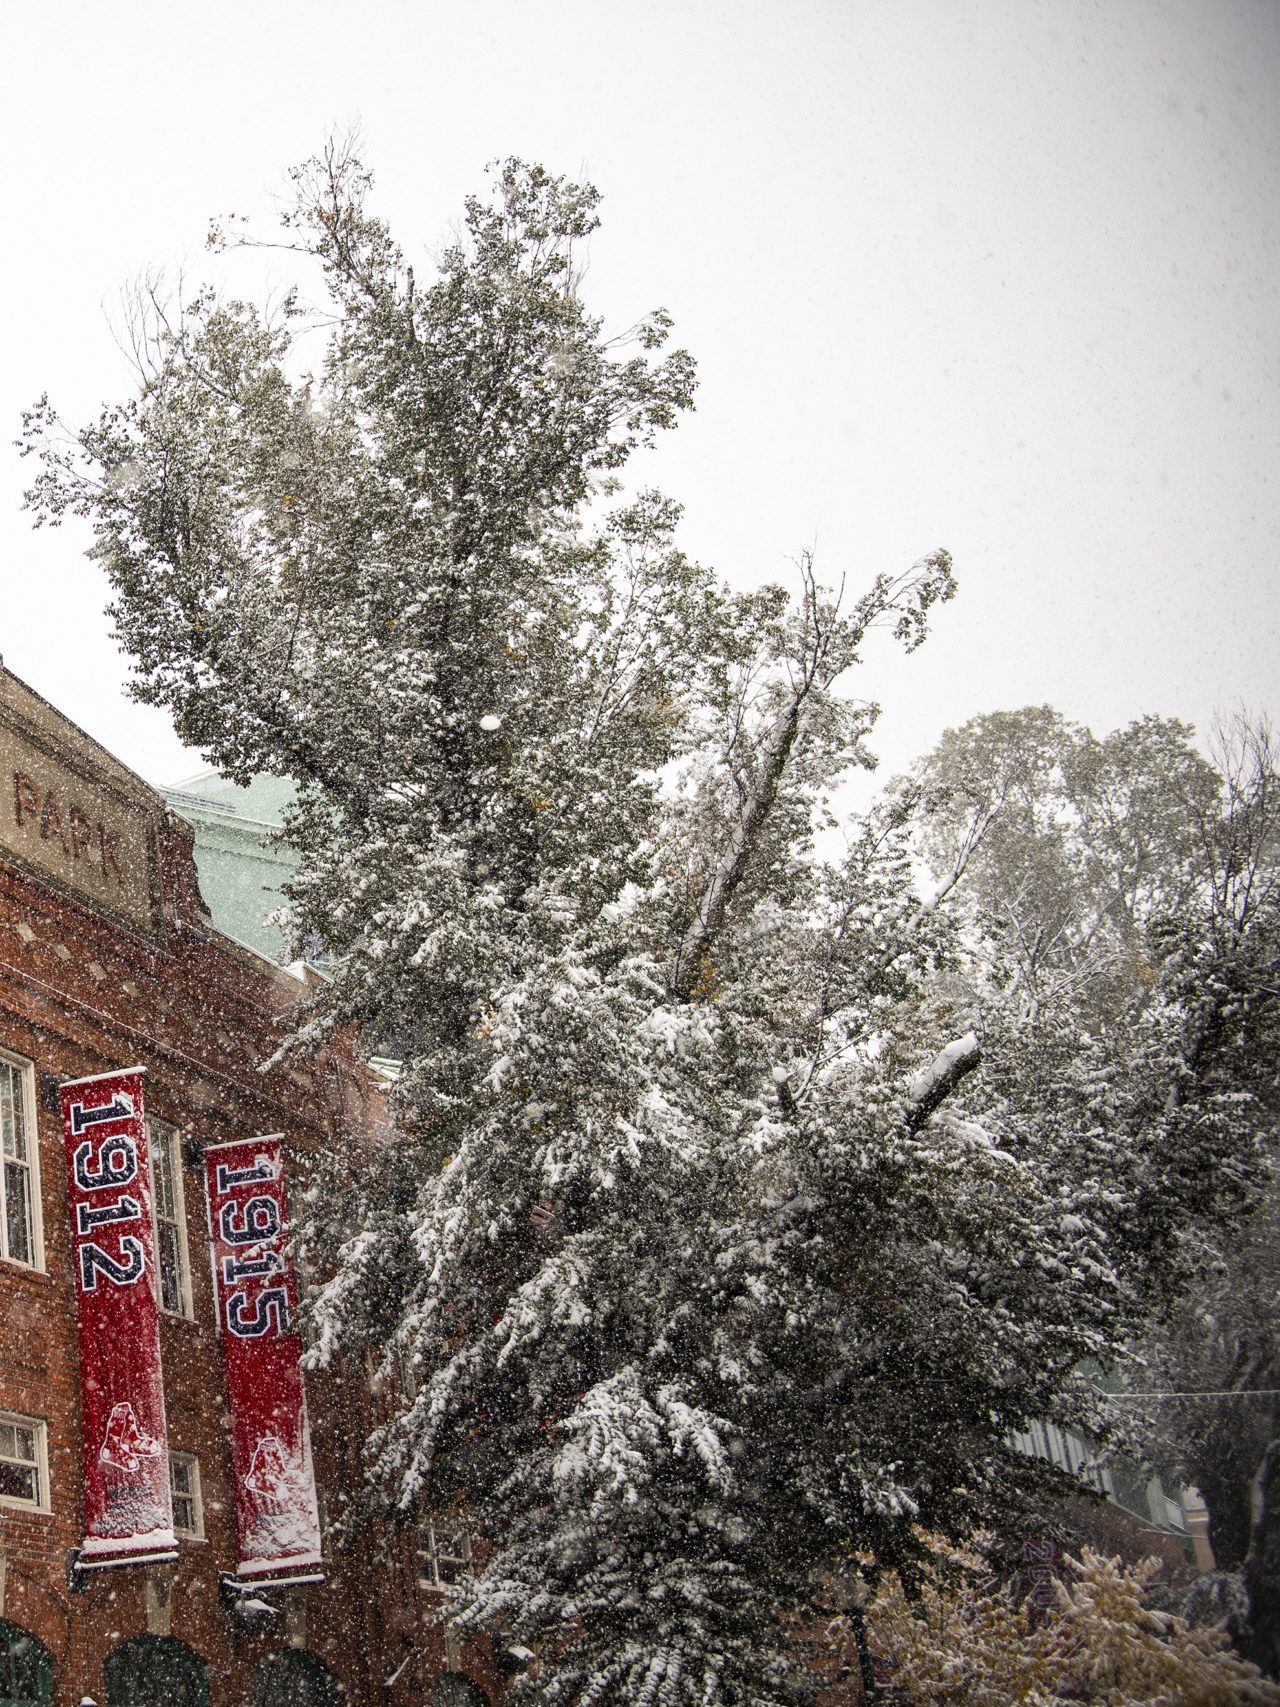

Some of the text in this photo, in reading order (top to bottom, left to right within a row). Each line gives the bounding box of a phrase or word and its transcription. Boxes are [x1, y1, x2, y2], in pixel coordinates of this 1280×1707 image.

[13, 770, 122, 877] PARK
[70, 1092, 146, 1292] 1912
[216, 1157, 292, 1338] 1915
